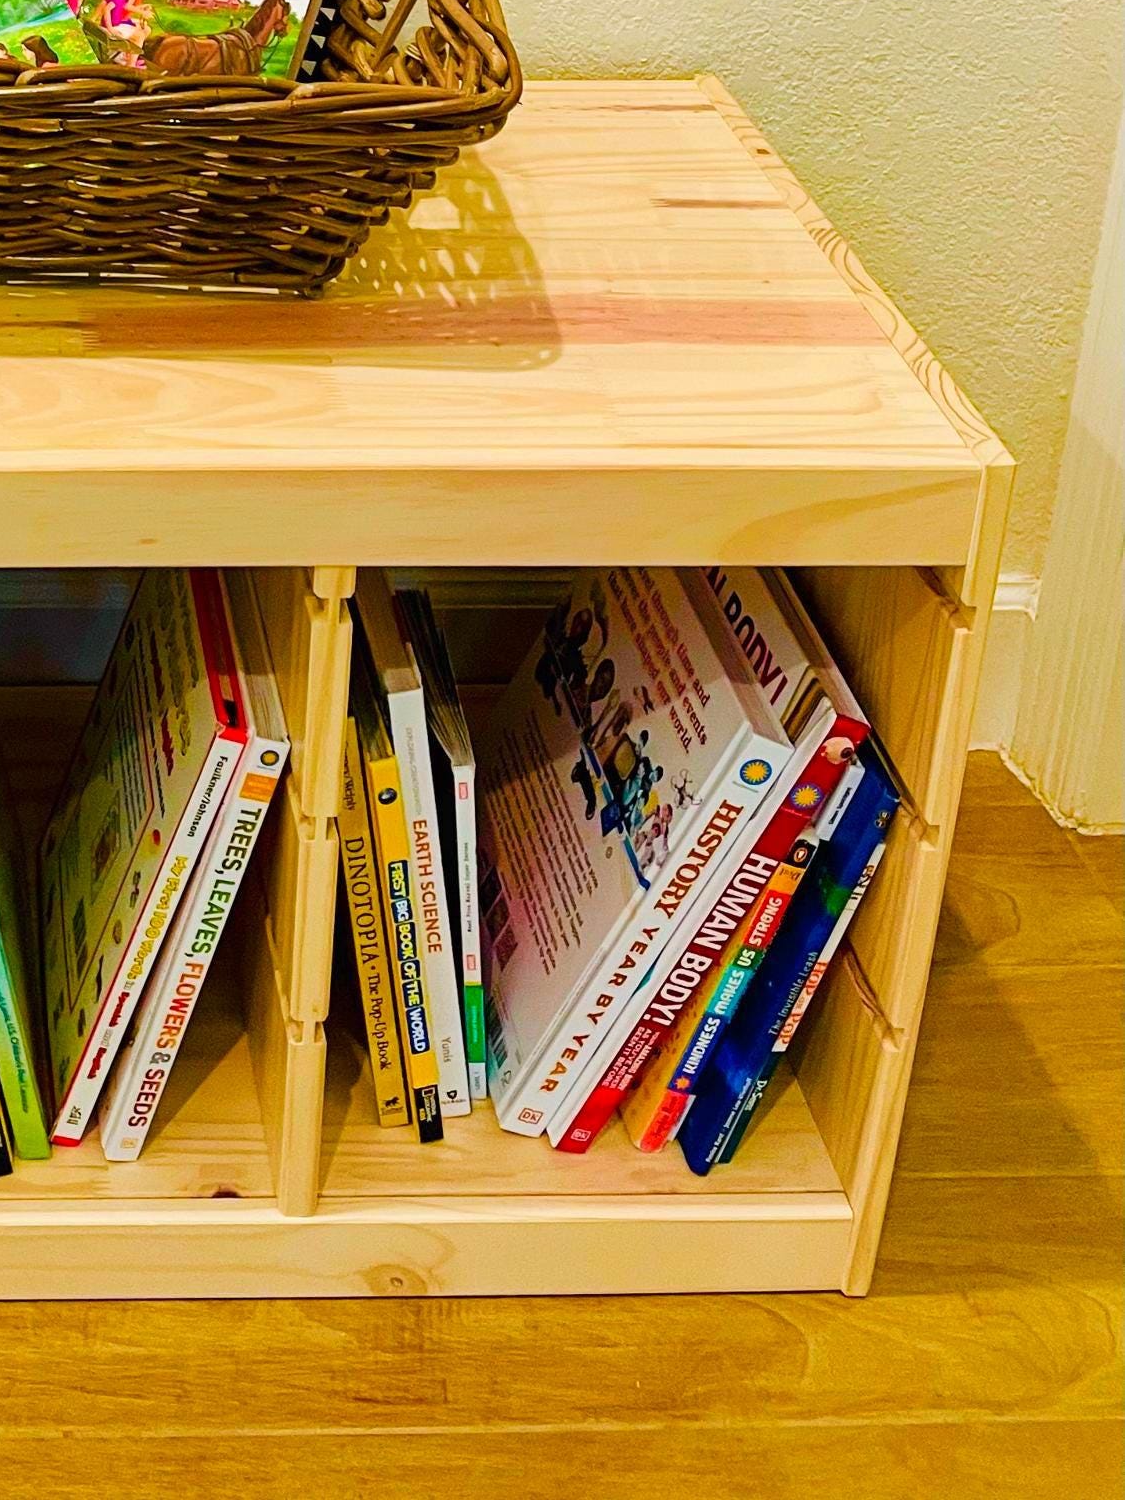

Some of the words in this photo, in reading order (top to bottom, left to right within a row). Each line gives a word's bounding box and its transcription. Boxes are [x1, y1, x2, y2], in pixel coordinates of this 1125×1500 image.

[677, 642, 695, 678] time
[693, 679, 711, 708] and
[683, 697, 707, 746] events
[187, 756, 228, 838] Faulkner/Johnson
[214, 807, 262, 875] TREES,
[413, 819, 434, 876] EARTH
[654, 800, 744, 920] HISTORY
[344, 835, 380, 965] DINOTOPIA
[389, 862, 408, 897] FIRST
[694, 852, 778, 951] HUMAN
[184, 877, 235, 958] LEAVES,
[392, 901, 410, 921] BIG
[398, 924, 416, 959] BOOK
[419, 882, 443, 954] SCIENCE
[402, 962, 419, 978] OF
[608, 925, 661, 987] YEAR
[682, 1017, 721, 1075] KINDNESS
[741, 949, 757, 968] US
[750, 897, 783, 947] STRONG
[155, 962, 204, 1049] FLOWERS
[404, 979, 423, 1006] THE
[586, 993, 614, 1026] BY
[643, 952, 714, 1026] BODY!
[149, 1051, 171, 1064] &
[408, 1007, 429, 1052] WORLD
[539, 1033, 591, 1093] YEAR
[128, 1068, 165, 1128] SEEDS
